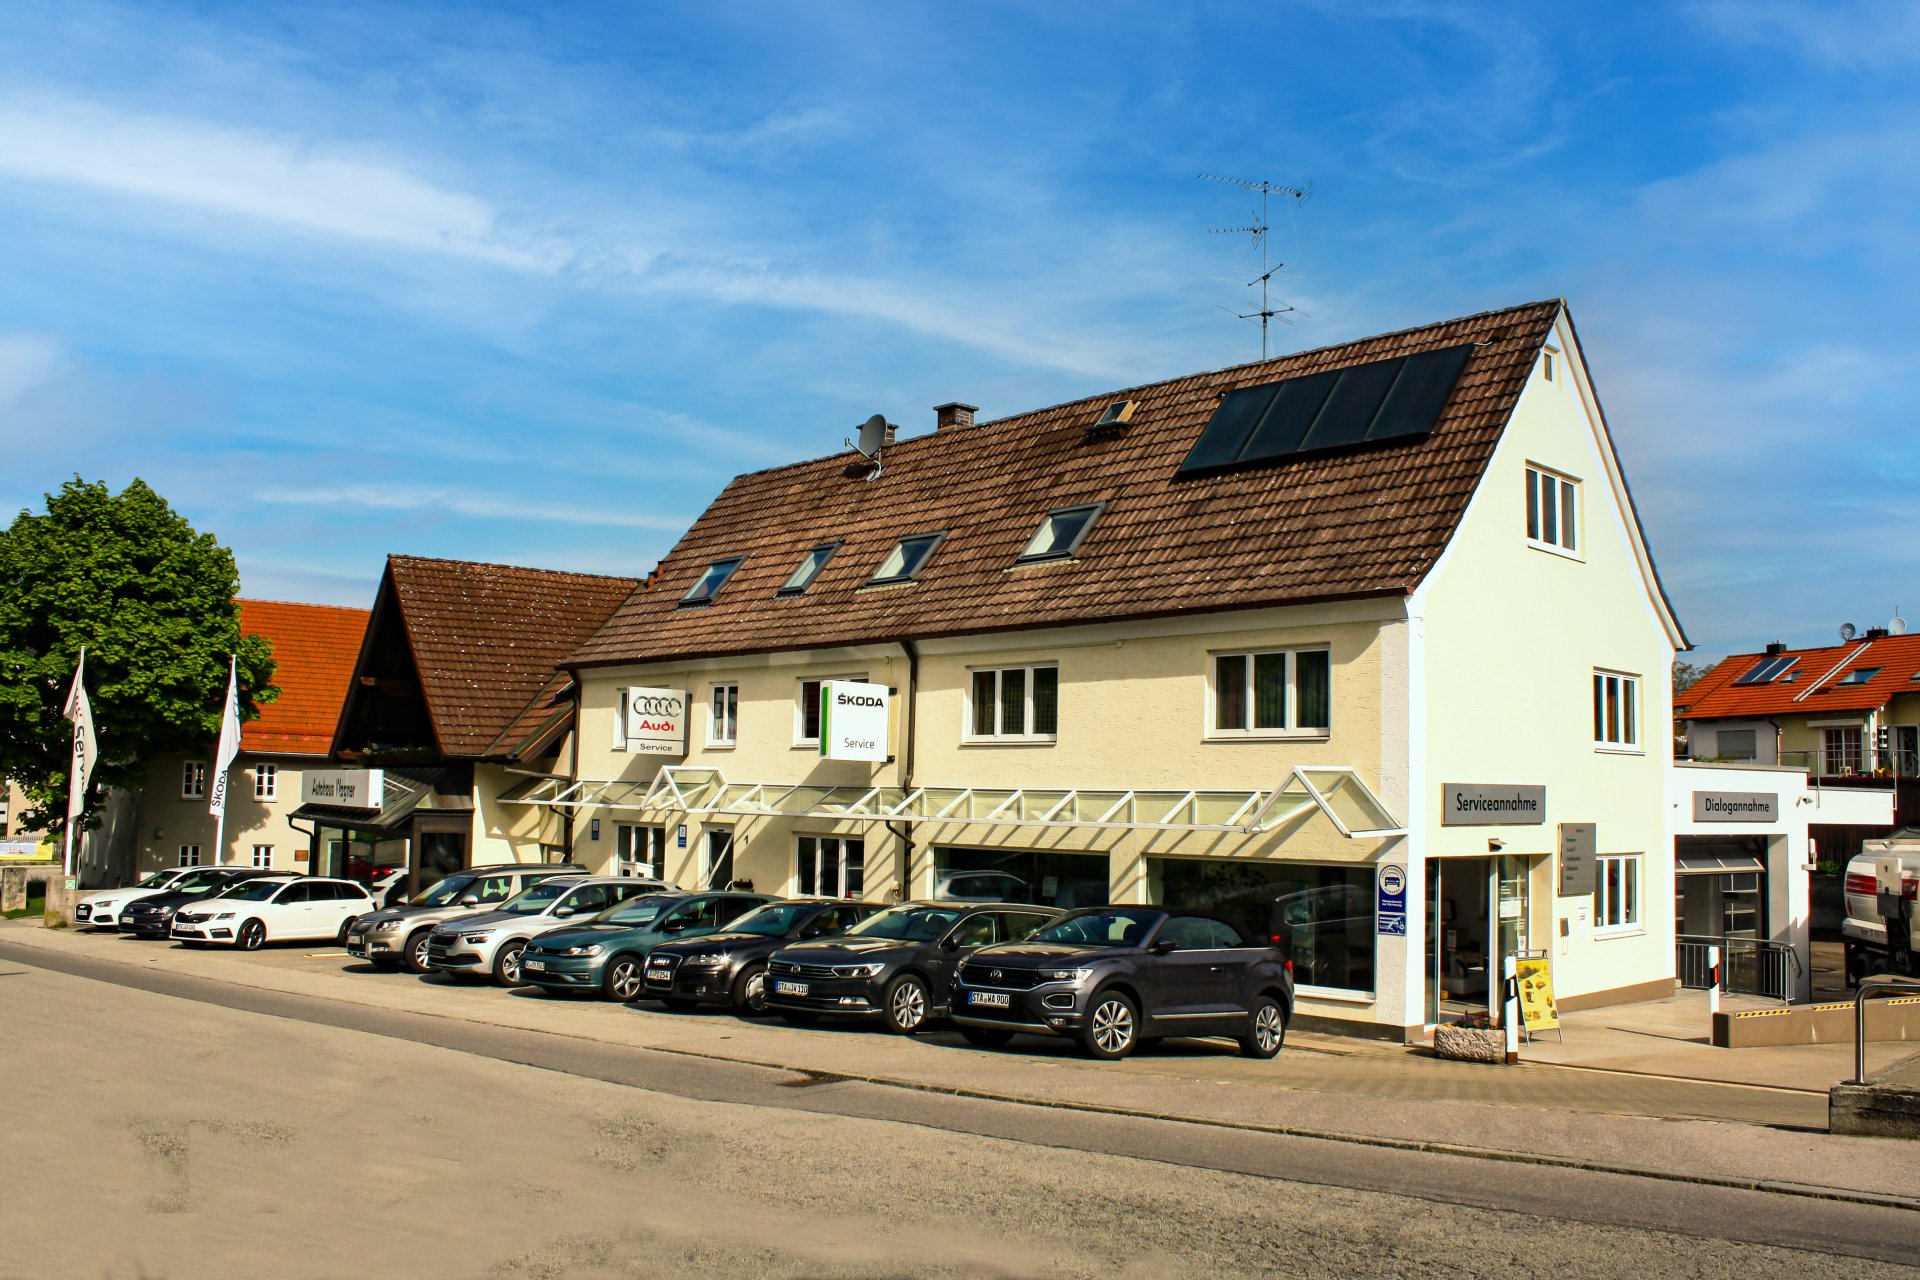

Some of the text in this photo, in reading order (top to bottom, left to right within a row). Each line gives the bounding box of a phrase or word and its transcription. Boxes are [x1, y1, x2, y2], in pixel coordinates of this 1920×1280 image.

[837, 693, 884, 708] ŠKODA
[640, 719, 675, 731] Audi
[640, 743, 673, 751] Service
[844, 737, 875, 750] Service
[312, 778, 356, 803] Autohaus Wagner
[1456, 792, 1537, 811] Serviceannahme
[1705, 797, 1770, 815] Dialogannahme
[972, 992, 984, 1002] STA
[996, 994, 1009, 1005] 900
